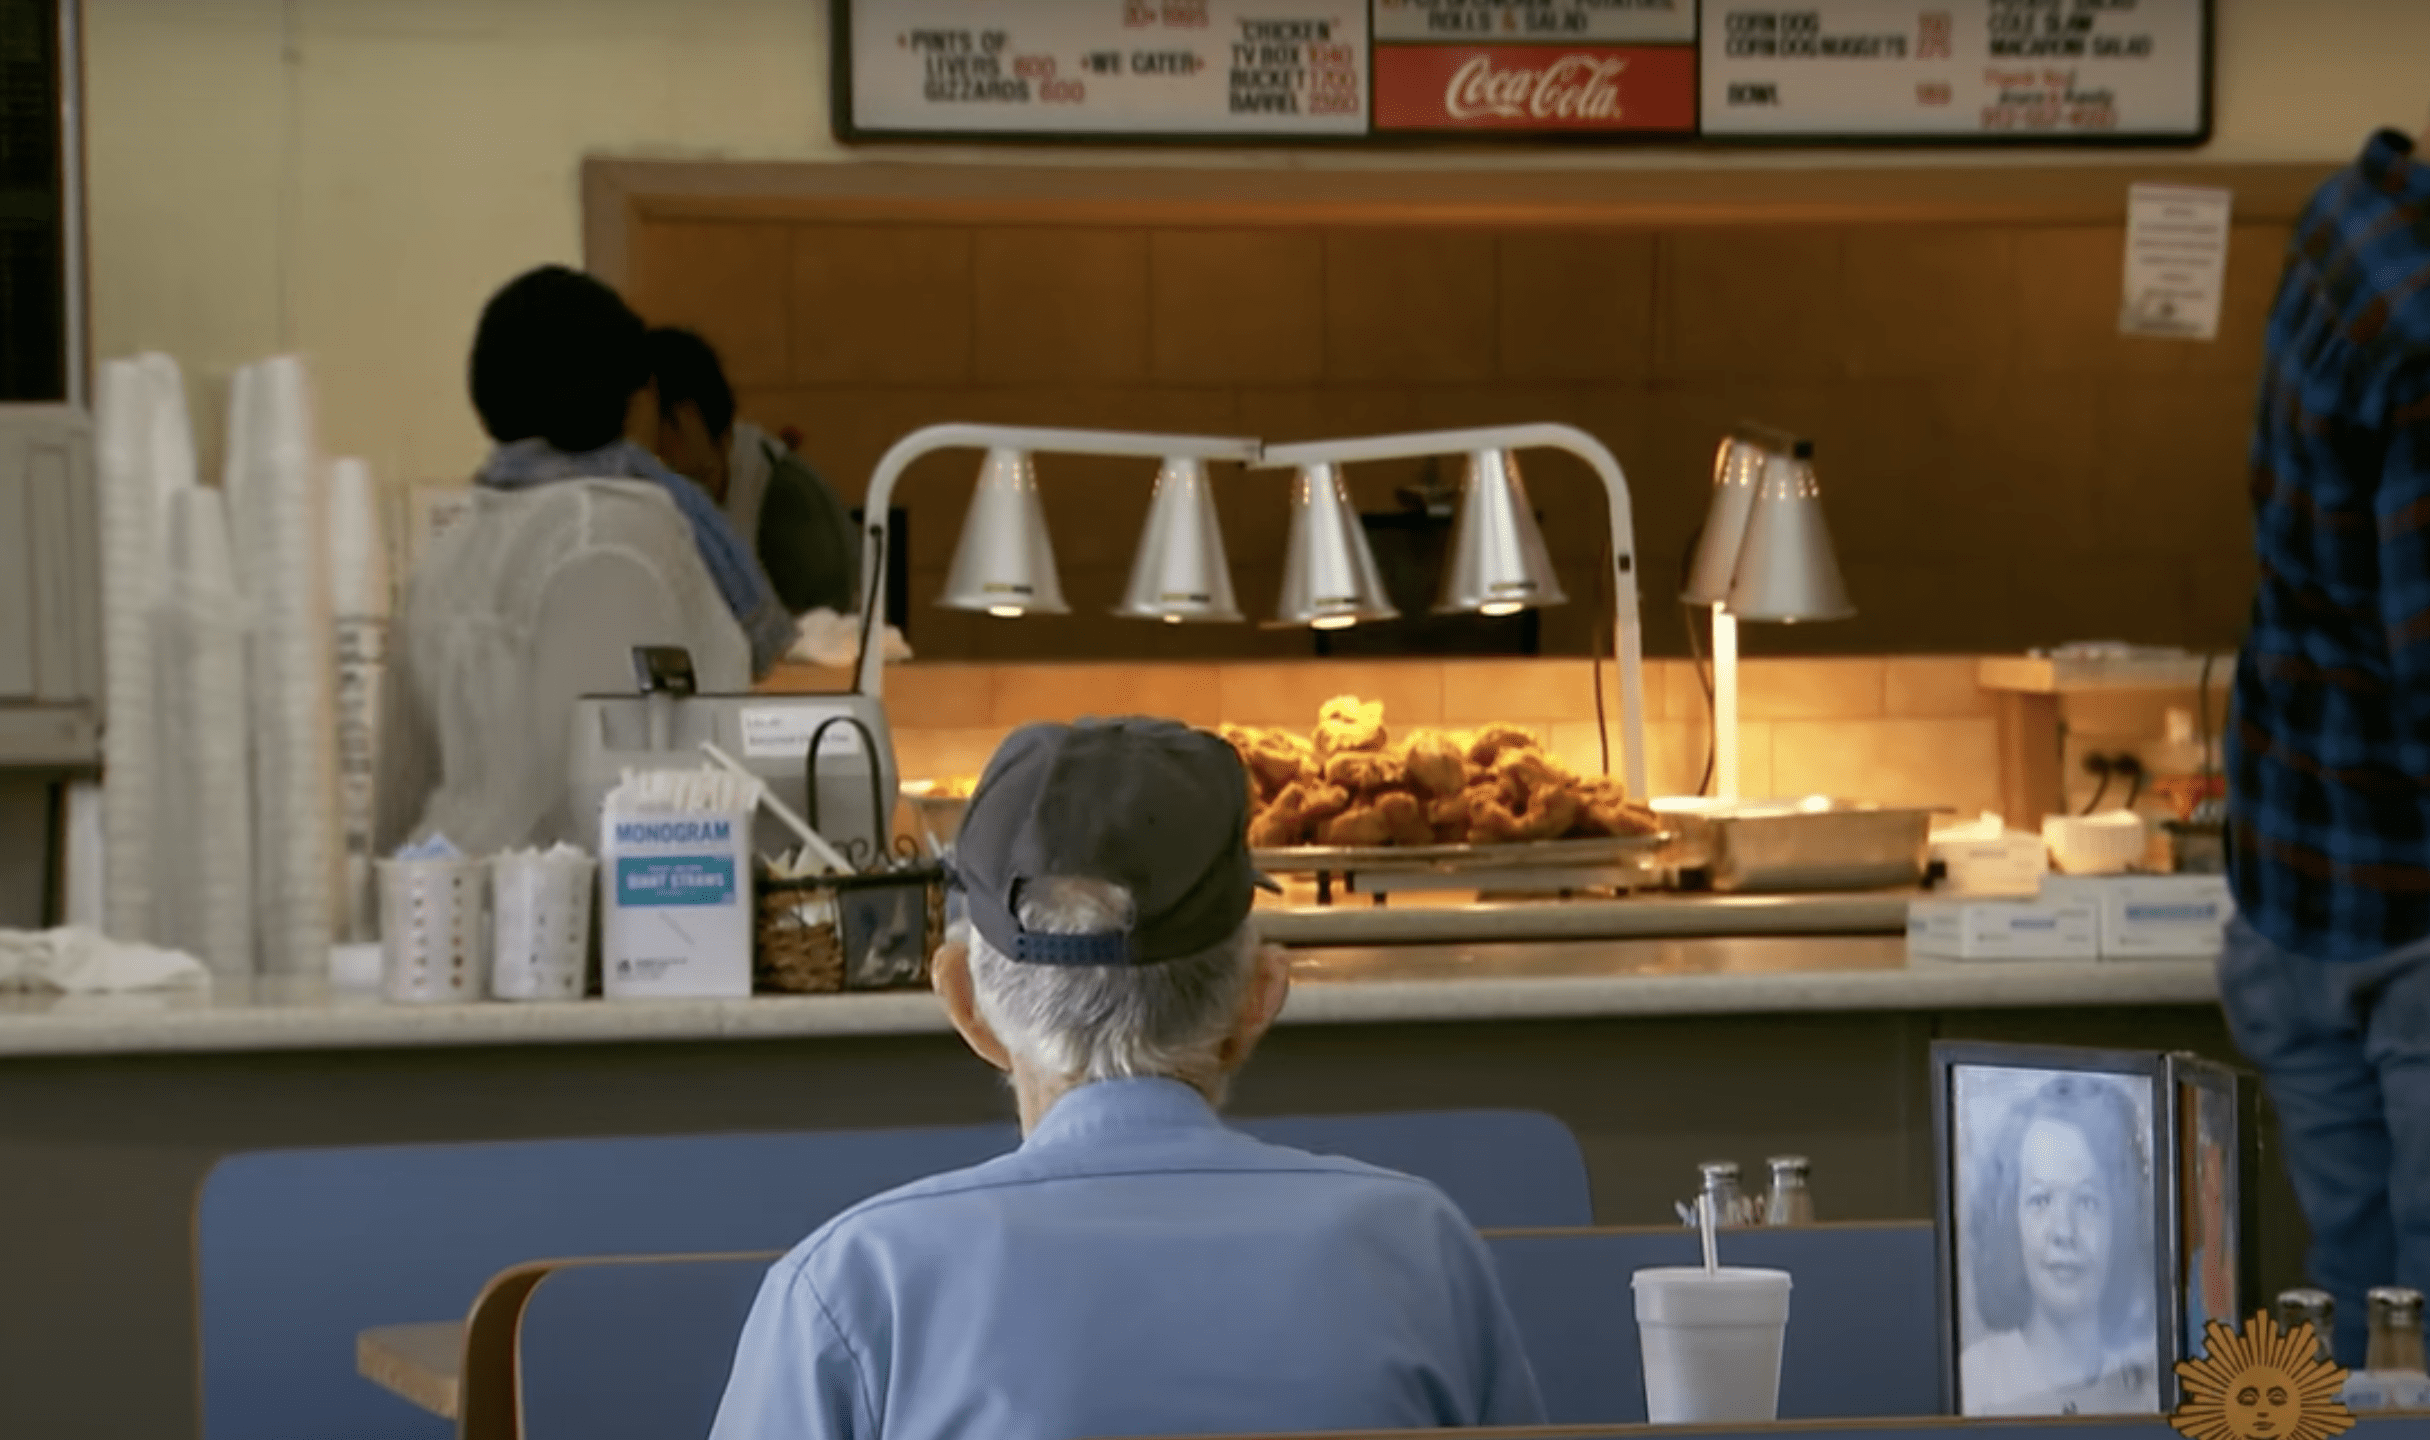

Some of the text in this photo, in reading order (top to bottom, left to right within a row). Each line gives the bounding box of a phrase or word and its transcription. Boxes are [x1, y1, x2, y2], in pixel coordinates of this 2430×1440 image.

[911, 30, 971, 51] PINTS
[926, 56, 999, 77] LIVERS
[1090, 51, 1194, 74] WE CATER
[1230, 69, 1303, 89] BUCKET
[1444, 53, 1629, 120] Coca-Cola
[924, 80, 1031, 102] GIZZARDS
[616, 822, 730, 843] MONOGRAM
